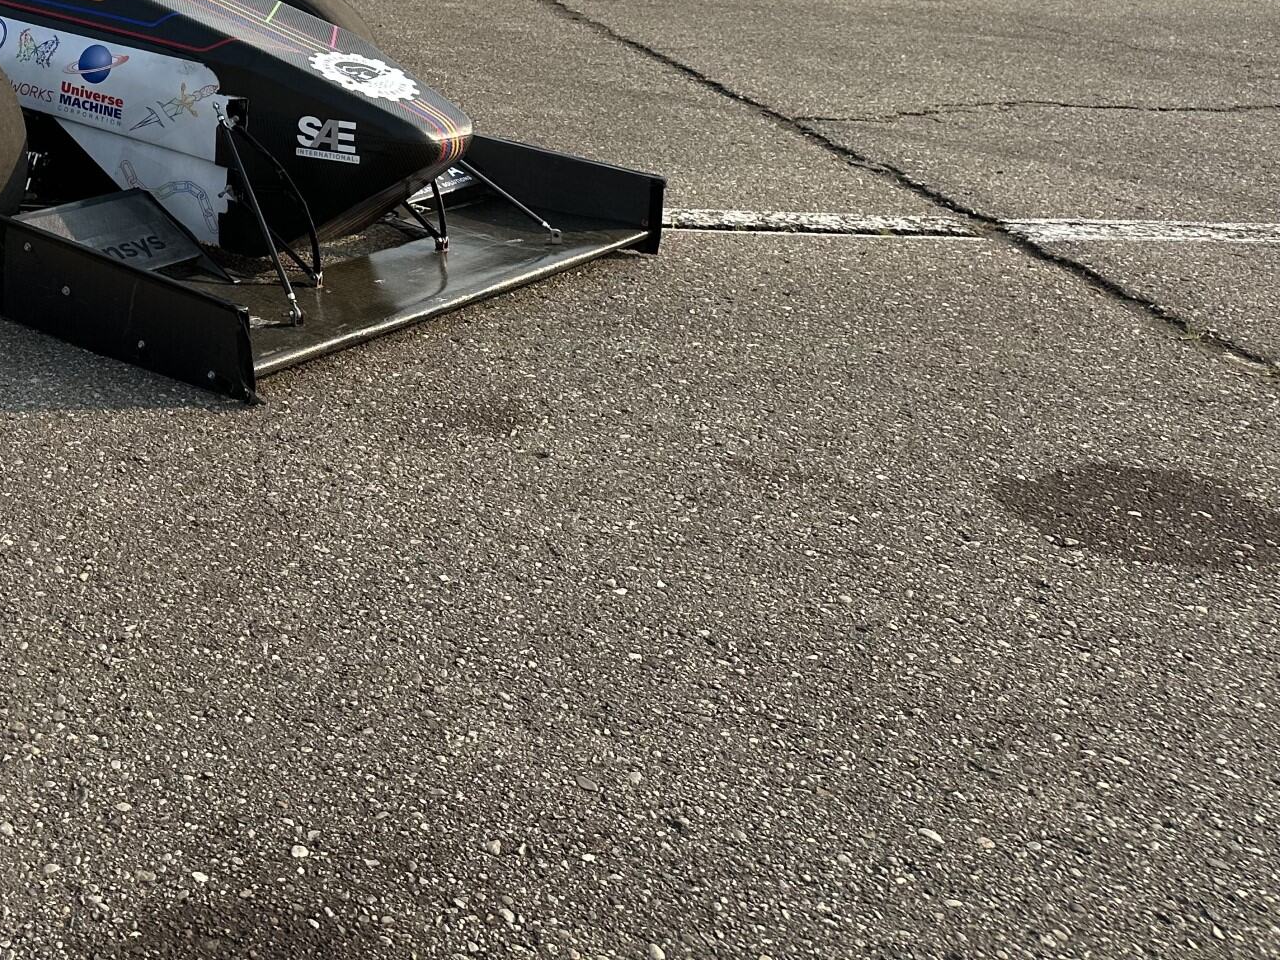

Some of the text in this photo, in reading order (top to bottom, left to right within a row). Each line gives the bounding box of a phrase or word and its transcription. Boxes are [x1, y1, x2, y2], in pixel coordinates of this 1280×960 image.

[59, 93, 123, 120] MACHINE
[60, 81, 124, 108] Universe
[296, 115, 357, 154] SAE
[101, 235, 166, 260] nsys
